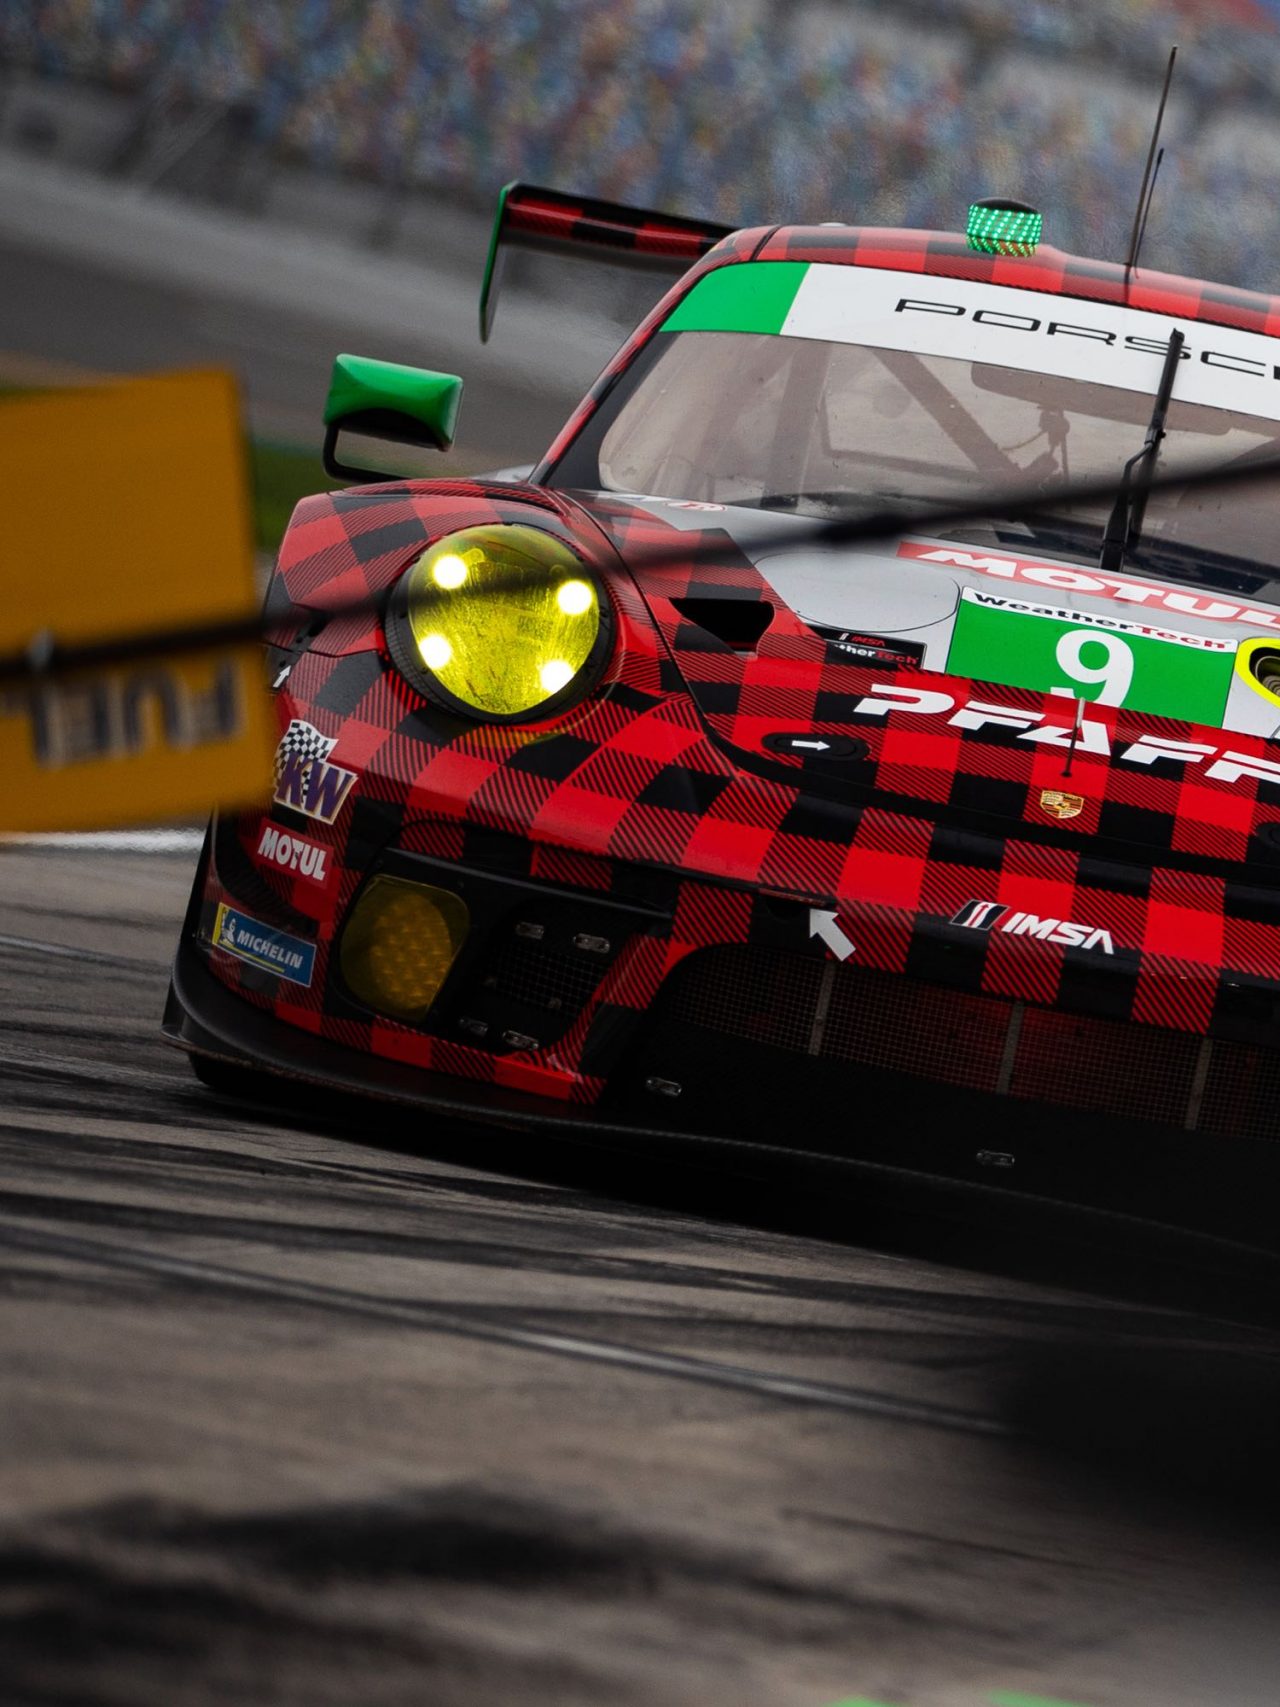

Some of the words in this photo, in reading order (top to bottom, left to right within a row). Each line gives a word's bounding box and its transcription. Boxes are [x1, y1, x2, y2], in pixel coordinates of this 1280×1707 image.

[974, 592, 1227, 650] WeatherTech
[1050, 628, 1135, 707] 9
[275, 750, 356, 822] KW
[257, 826, 327, 881] MOTUL
[237, 929, 303, 969] MICHELIN
[1001, 911, 1114, 955] IMSA
